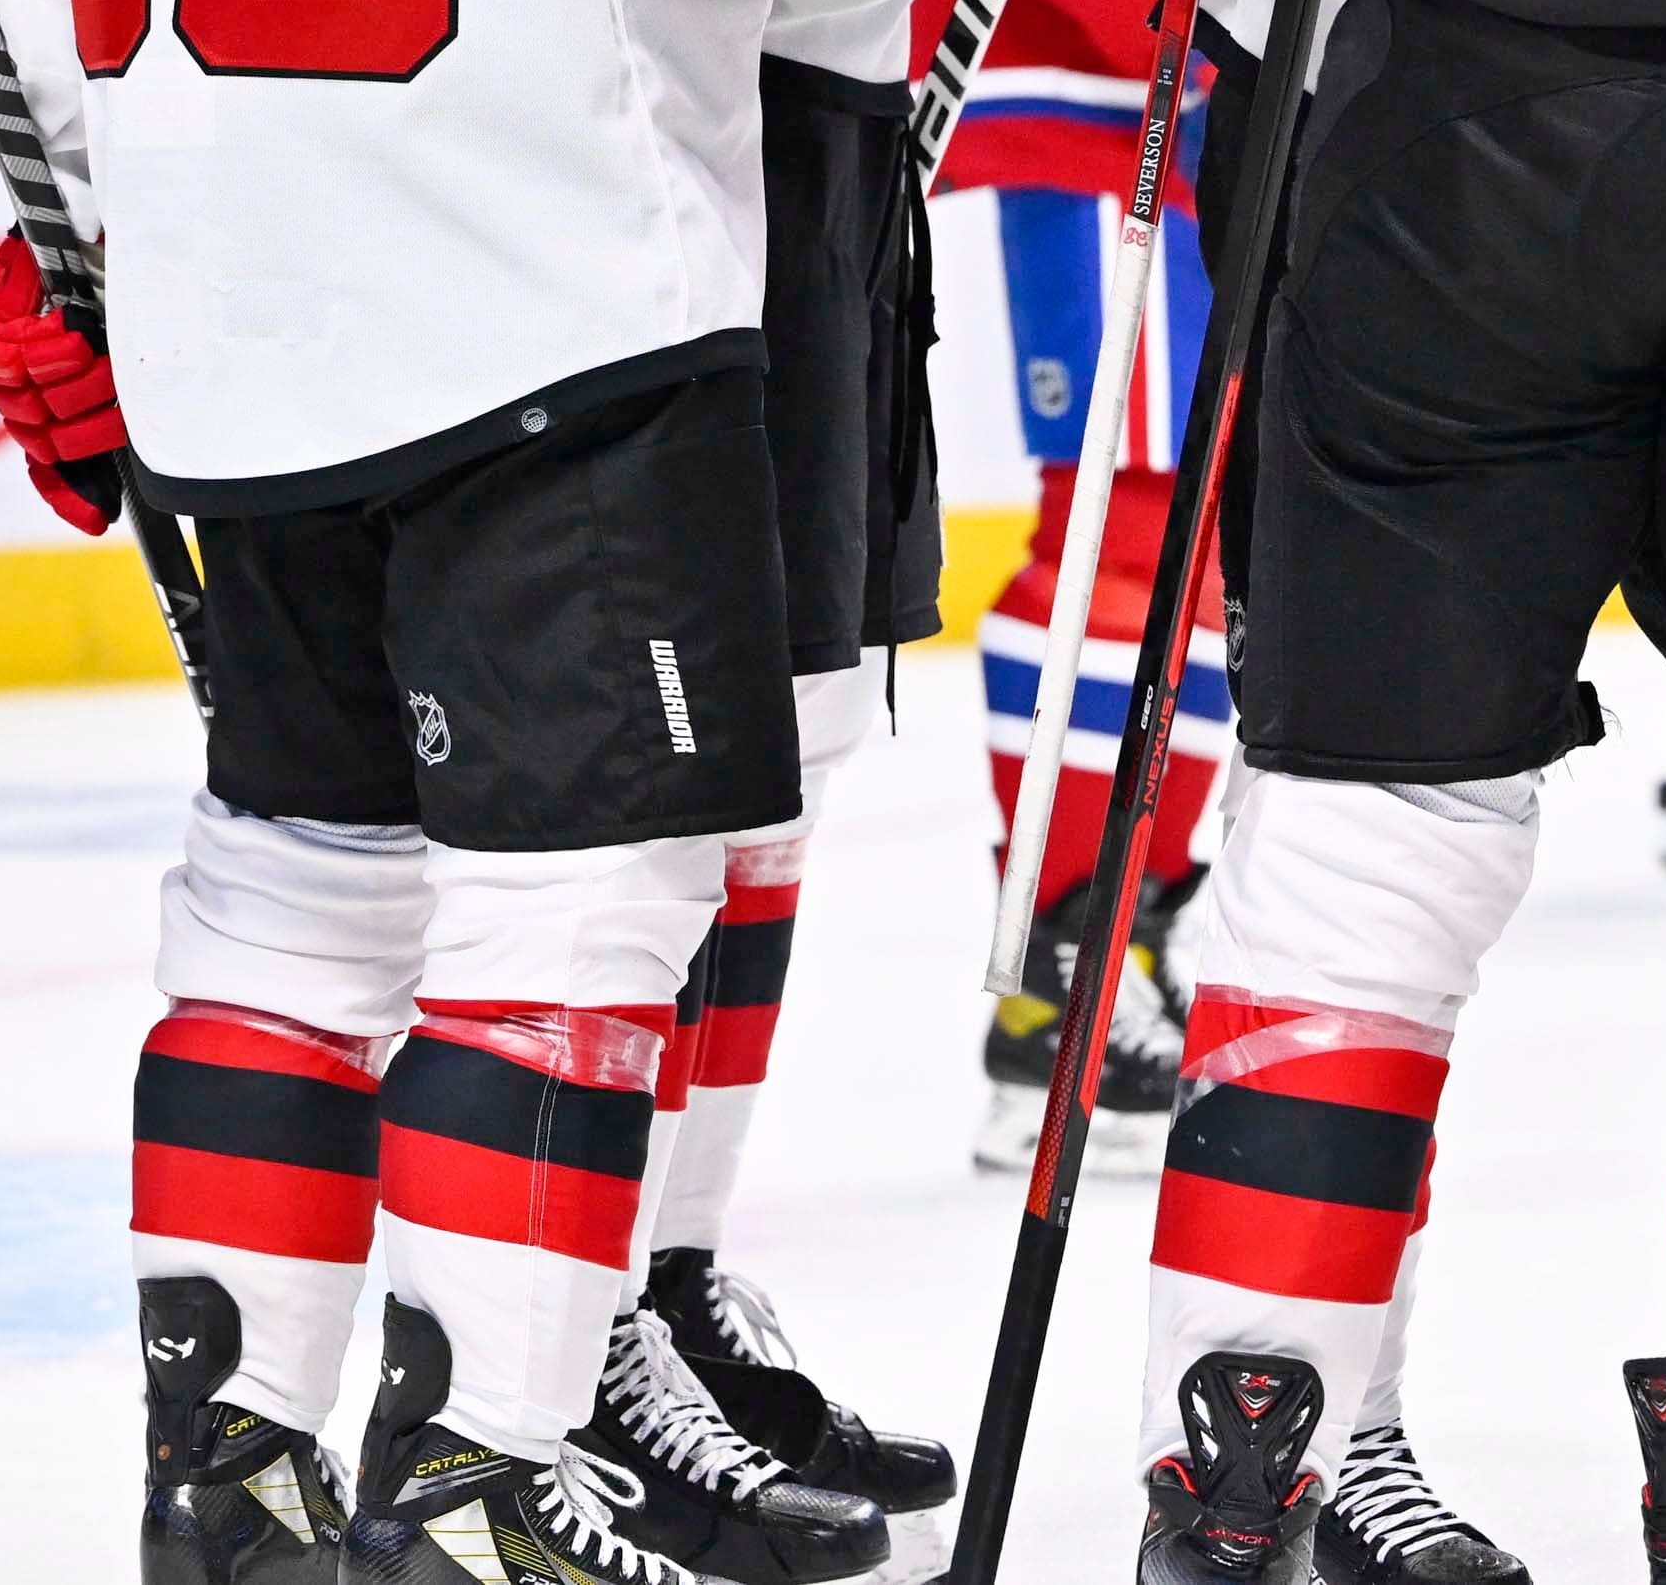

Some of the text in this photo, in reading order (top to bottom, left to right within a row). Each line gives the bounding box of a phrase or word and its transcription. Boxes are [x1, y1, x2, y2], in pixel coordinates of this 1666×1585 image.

[1134, 118, 1166, 215] SEVERSON
[649, 639, 697, 754] WARRIOR
[1140, 684, 1154, 730] GEO
[1143, 696, 1175, 806] NEXUS
[319, 1523, 341, 1543] PRO
